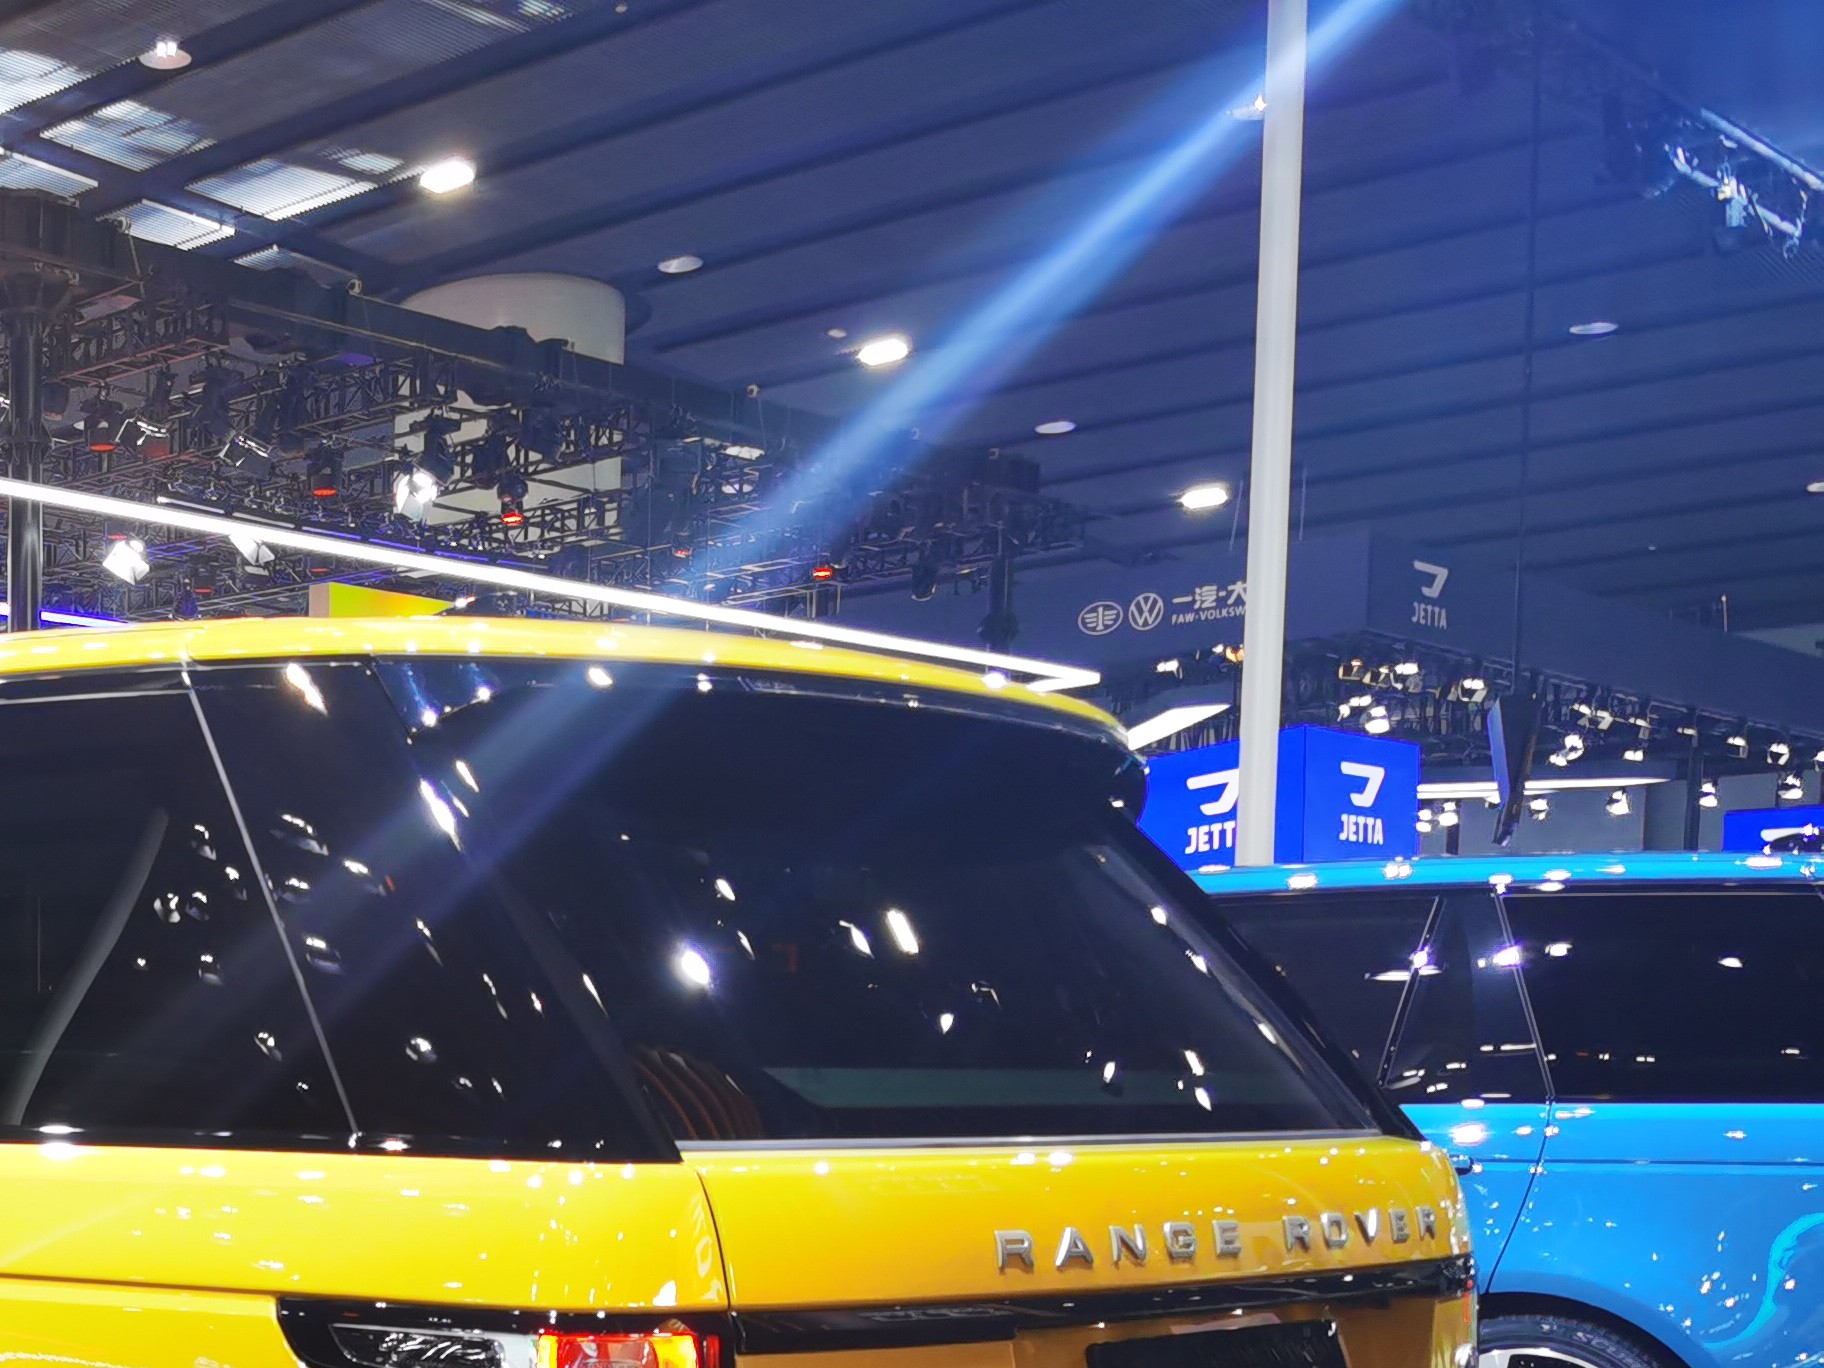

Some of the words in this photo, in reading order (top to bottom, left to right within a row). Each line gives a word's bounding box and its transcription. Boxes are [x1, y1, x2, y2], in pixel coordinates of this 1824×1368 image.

[1172, 580, 1247, 609] 一汽-大
[1171, 606, 1246, 626] FAW-VOLKSW
[1411, 601, 1447, 630] JETTA
[1184, 820, 1237, 855] JETT
[1339, 813, 1384, 845] JETTA
[994, 1220, 1242, 1270] RANGE
[1283, 1206, 1436, 1252] ROVER
